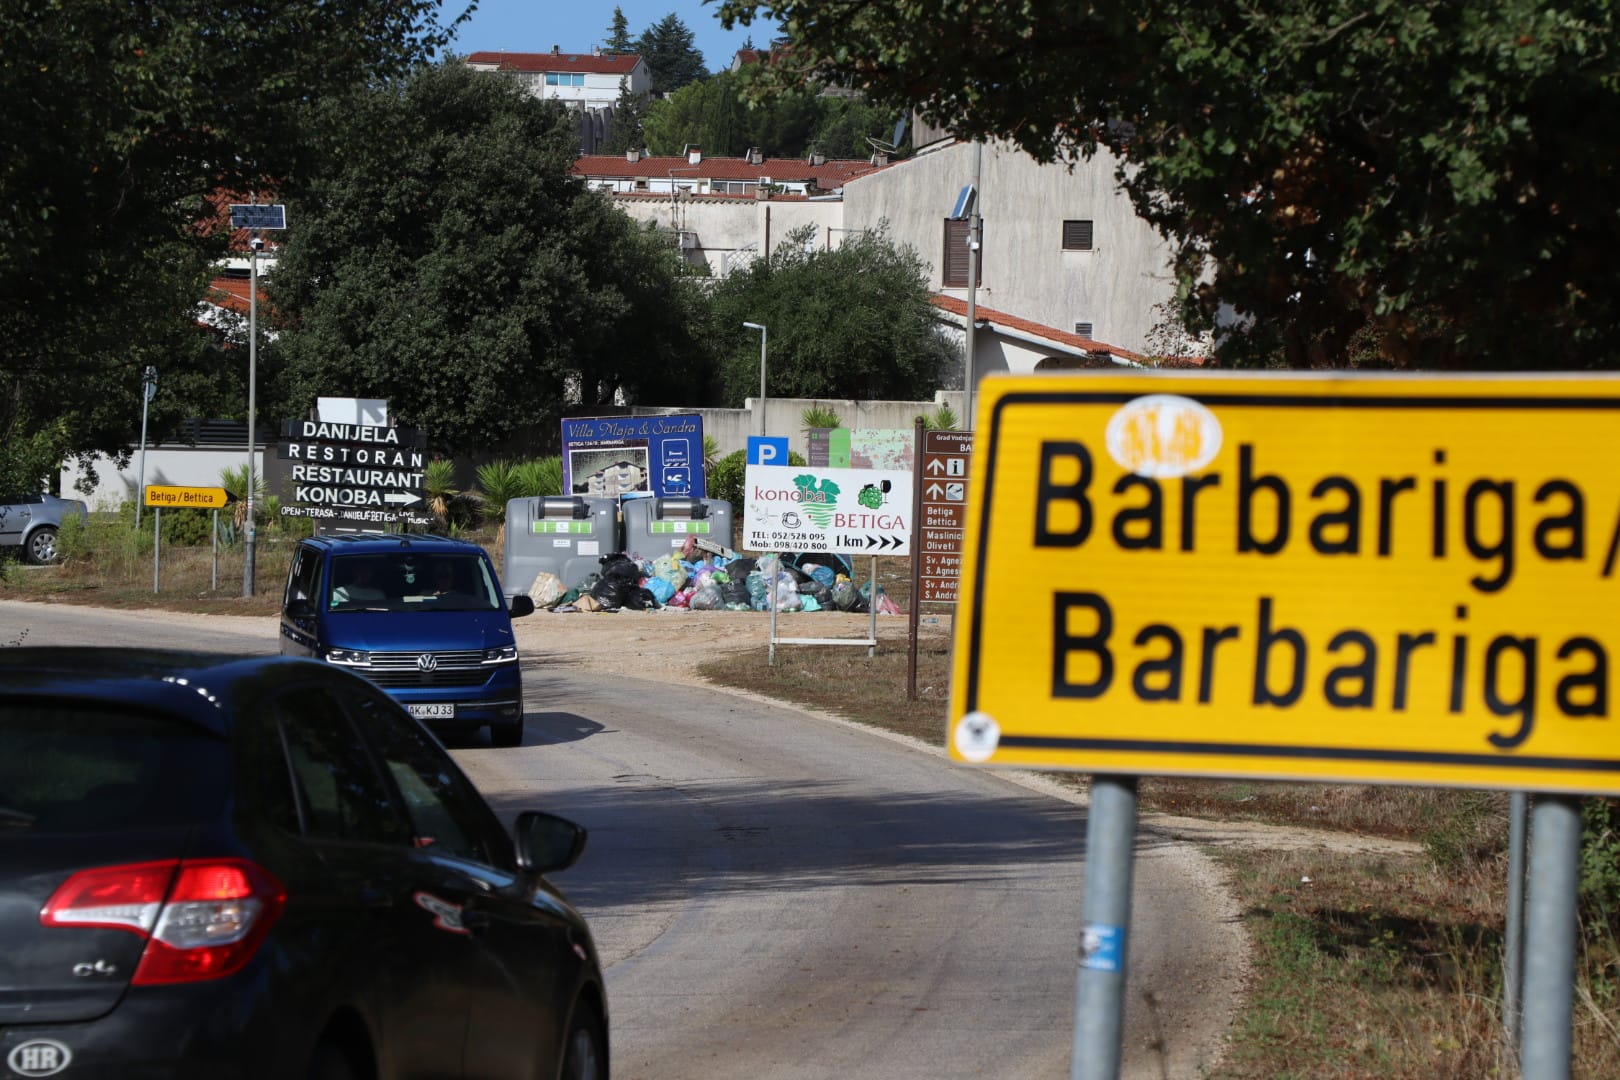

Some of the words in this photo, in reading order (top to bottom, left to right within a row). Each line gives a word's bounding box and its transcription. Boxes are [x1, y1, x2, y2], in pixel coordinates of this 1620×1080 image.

[303, 422, 399, 444] DANIJELA
[569, 424, 594, 438] Villa
[599, 422, 635, 439] Maja
[652, 419, 696, 435] Sandra
[288, 443, 422, 467] RESTORAN
[758, 444, 777, 465] P
[292, 465, 424, 489] RESTAURANT
[151, 491, 176, 503] Betiga
[183, 492, 213, 503] Bettica
[296, 486, 382, 505] KONOBA
[755, 486, 826, 502] konoba
[927, 507, 953, 517] Betiga
[835, 513, 905, 530] BETIGA
[927, 517, 957, 526] Bettica
[752, 531, 769, 539] TEL:
[809, 533, 826, 541] 095
[844, 535, 863, 548] km
[750, 540, 771, 548] Mob:
[811, 542, 828, 550] 800
[926, 541, 955, 550] Oliveti
[926, 556, 938, 564] Sv.
[925, 566, 934, 575] S.
[925, 580, 938, 589] Sv.
[925, 590, 933, 599] S.
[935, 590, 959, 599] Andre
[1050, 590, 1609, 749] Barbariga
[21, 1047, 58, 1070] HR
